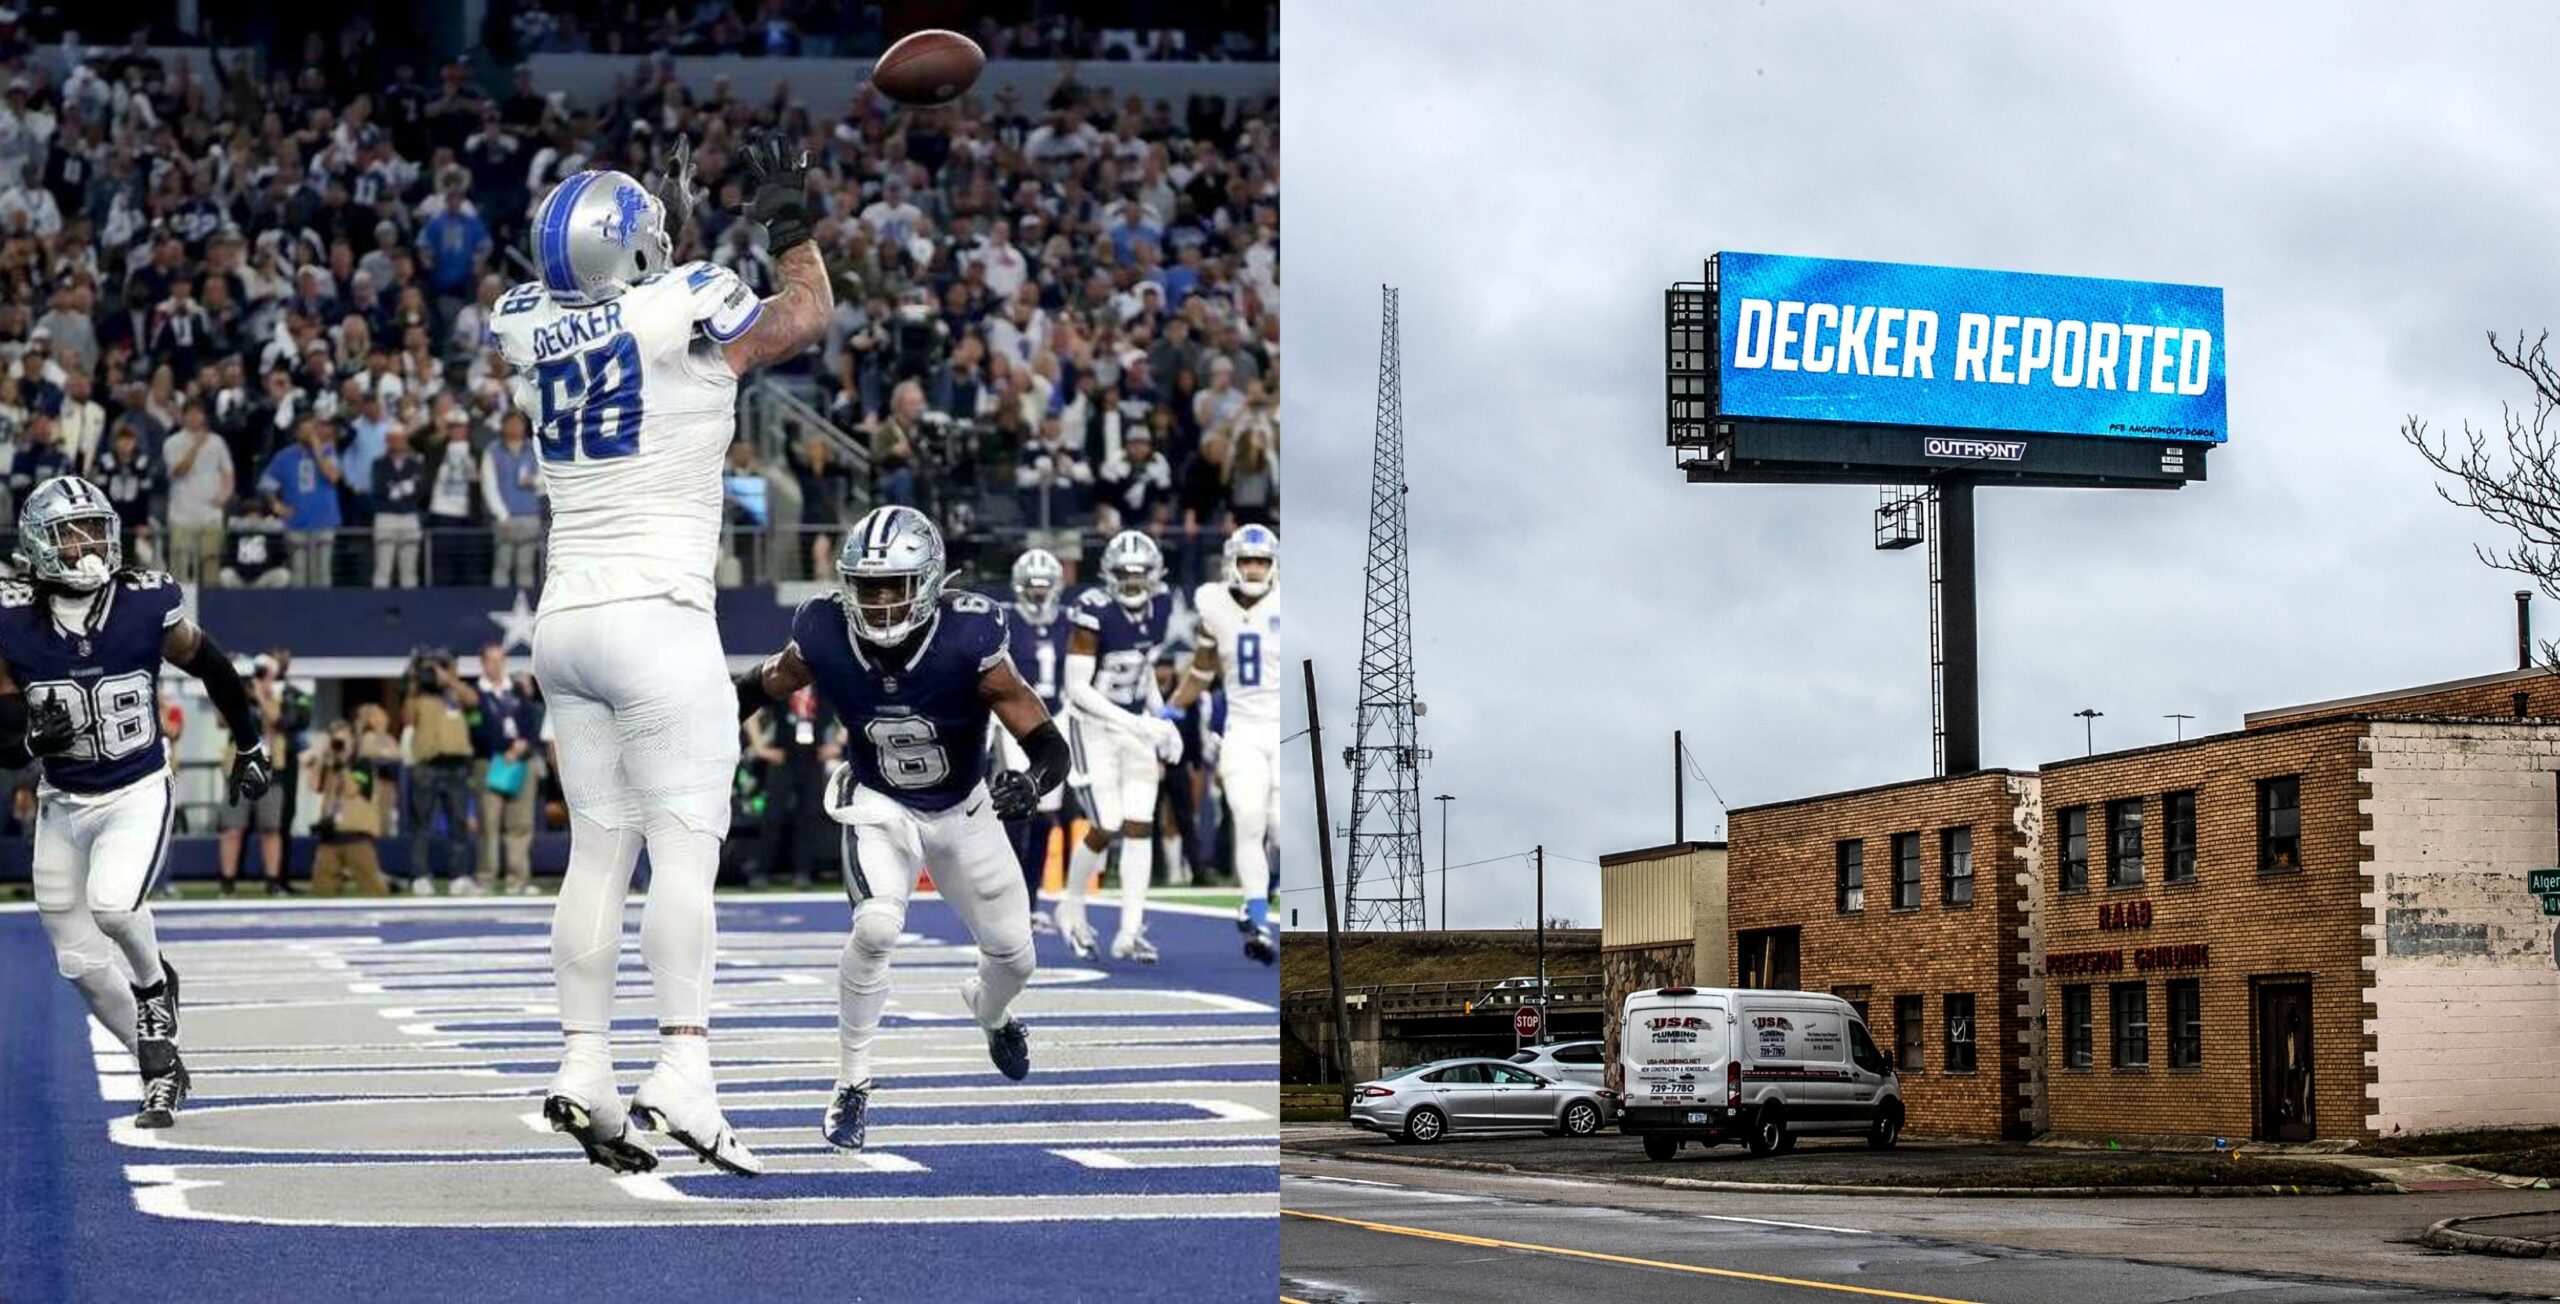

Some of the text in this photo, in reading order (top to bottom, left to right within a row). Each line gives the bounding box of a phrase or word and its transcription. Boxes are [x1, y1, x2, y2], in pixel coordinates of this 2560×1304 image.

[532, 301, 624, 360] DECKER
[1734, 298, 2212, 396] DECKER REPORTED
[538, 331, 643, 462] 68
[2129, 425, 2184, 436] ANONYMOUS
[2185, 428, 2216, 438] DONOR
[1928, 440, 2020, 458] OUTFRONT
[1237, 633, 1262, 686] 8
[25, 669, 156, 761] 28
[864, 715, 950, 789] 6
[2098, 899, 2153, 930] RAAB
[2045, 949, 2124, 975] PRECISION
[1516, 1016, 1539, 1027] STOP
[1652, 1016, 1699, 1031] USA
[1756, 1017, 1789, 1030] USA
[1652, 1031, 1697, 1039] PLUMBING
[1651, 1084, 1695, 1093] 739-7780
